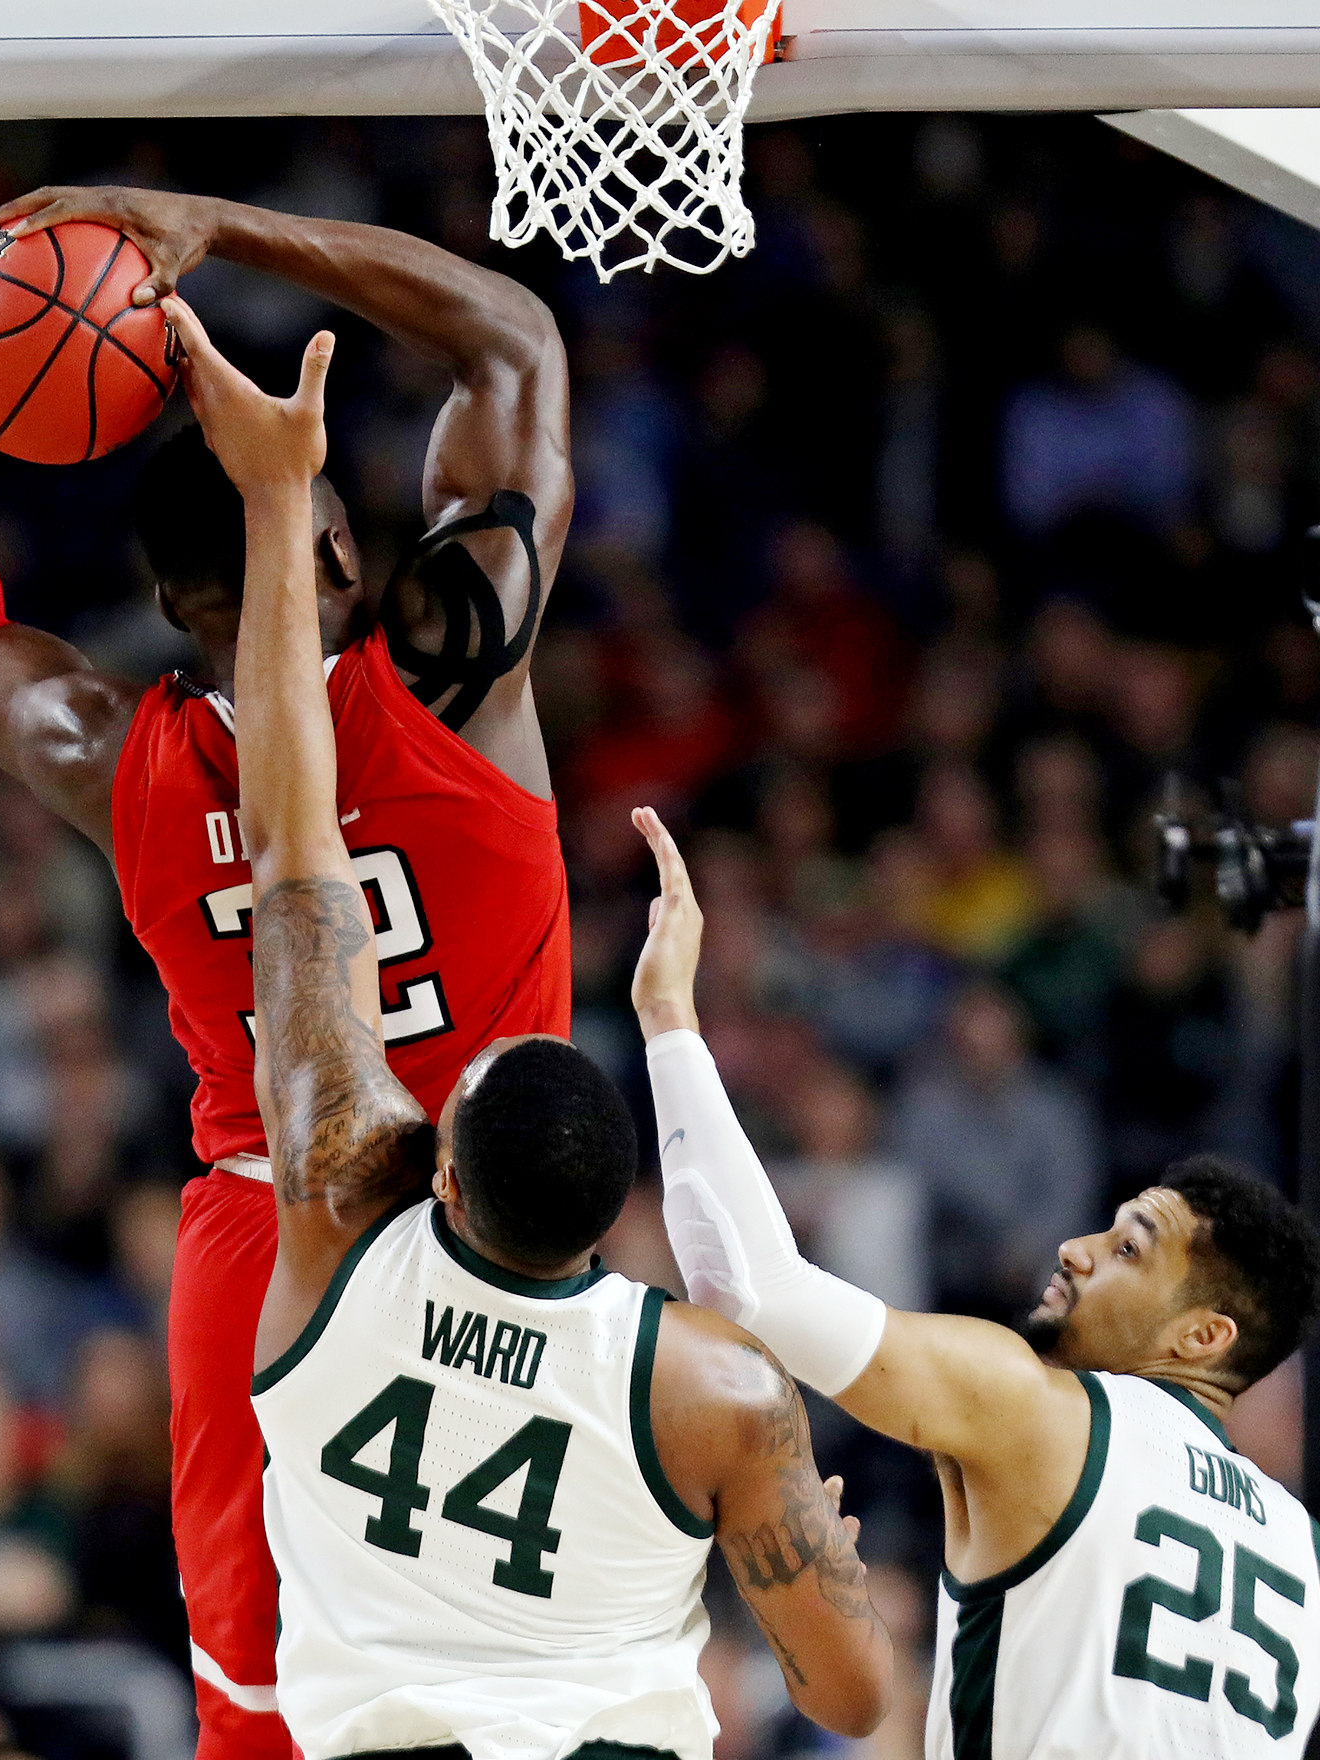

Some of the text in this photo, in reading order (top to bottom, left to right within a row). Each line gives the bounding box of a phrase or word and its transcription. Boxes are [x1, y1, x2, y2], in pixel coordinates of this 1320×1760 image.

[421, 1298, 547, 1389] WARD
[320, 1373, 573, 1599] 44
[1184, 1441, 1267, 1526] GOINS
[1112, 1504, 1307, 1741] 25
